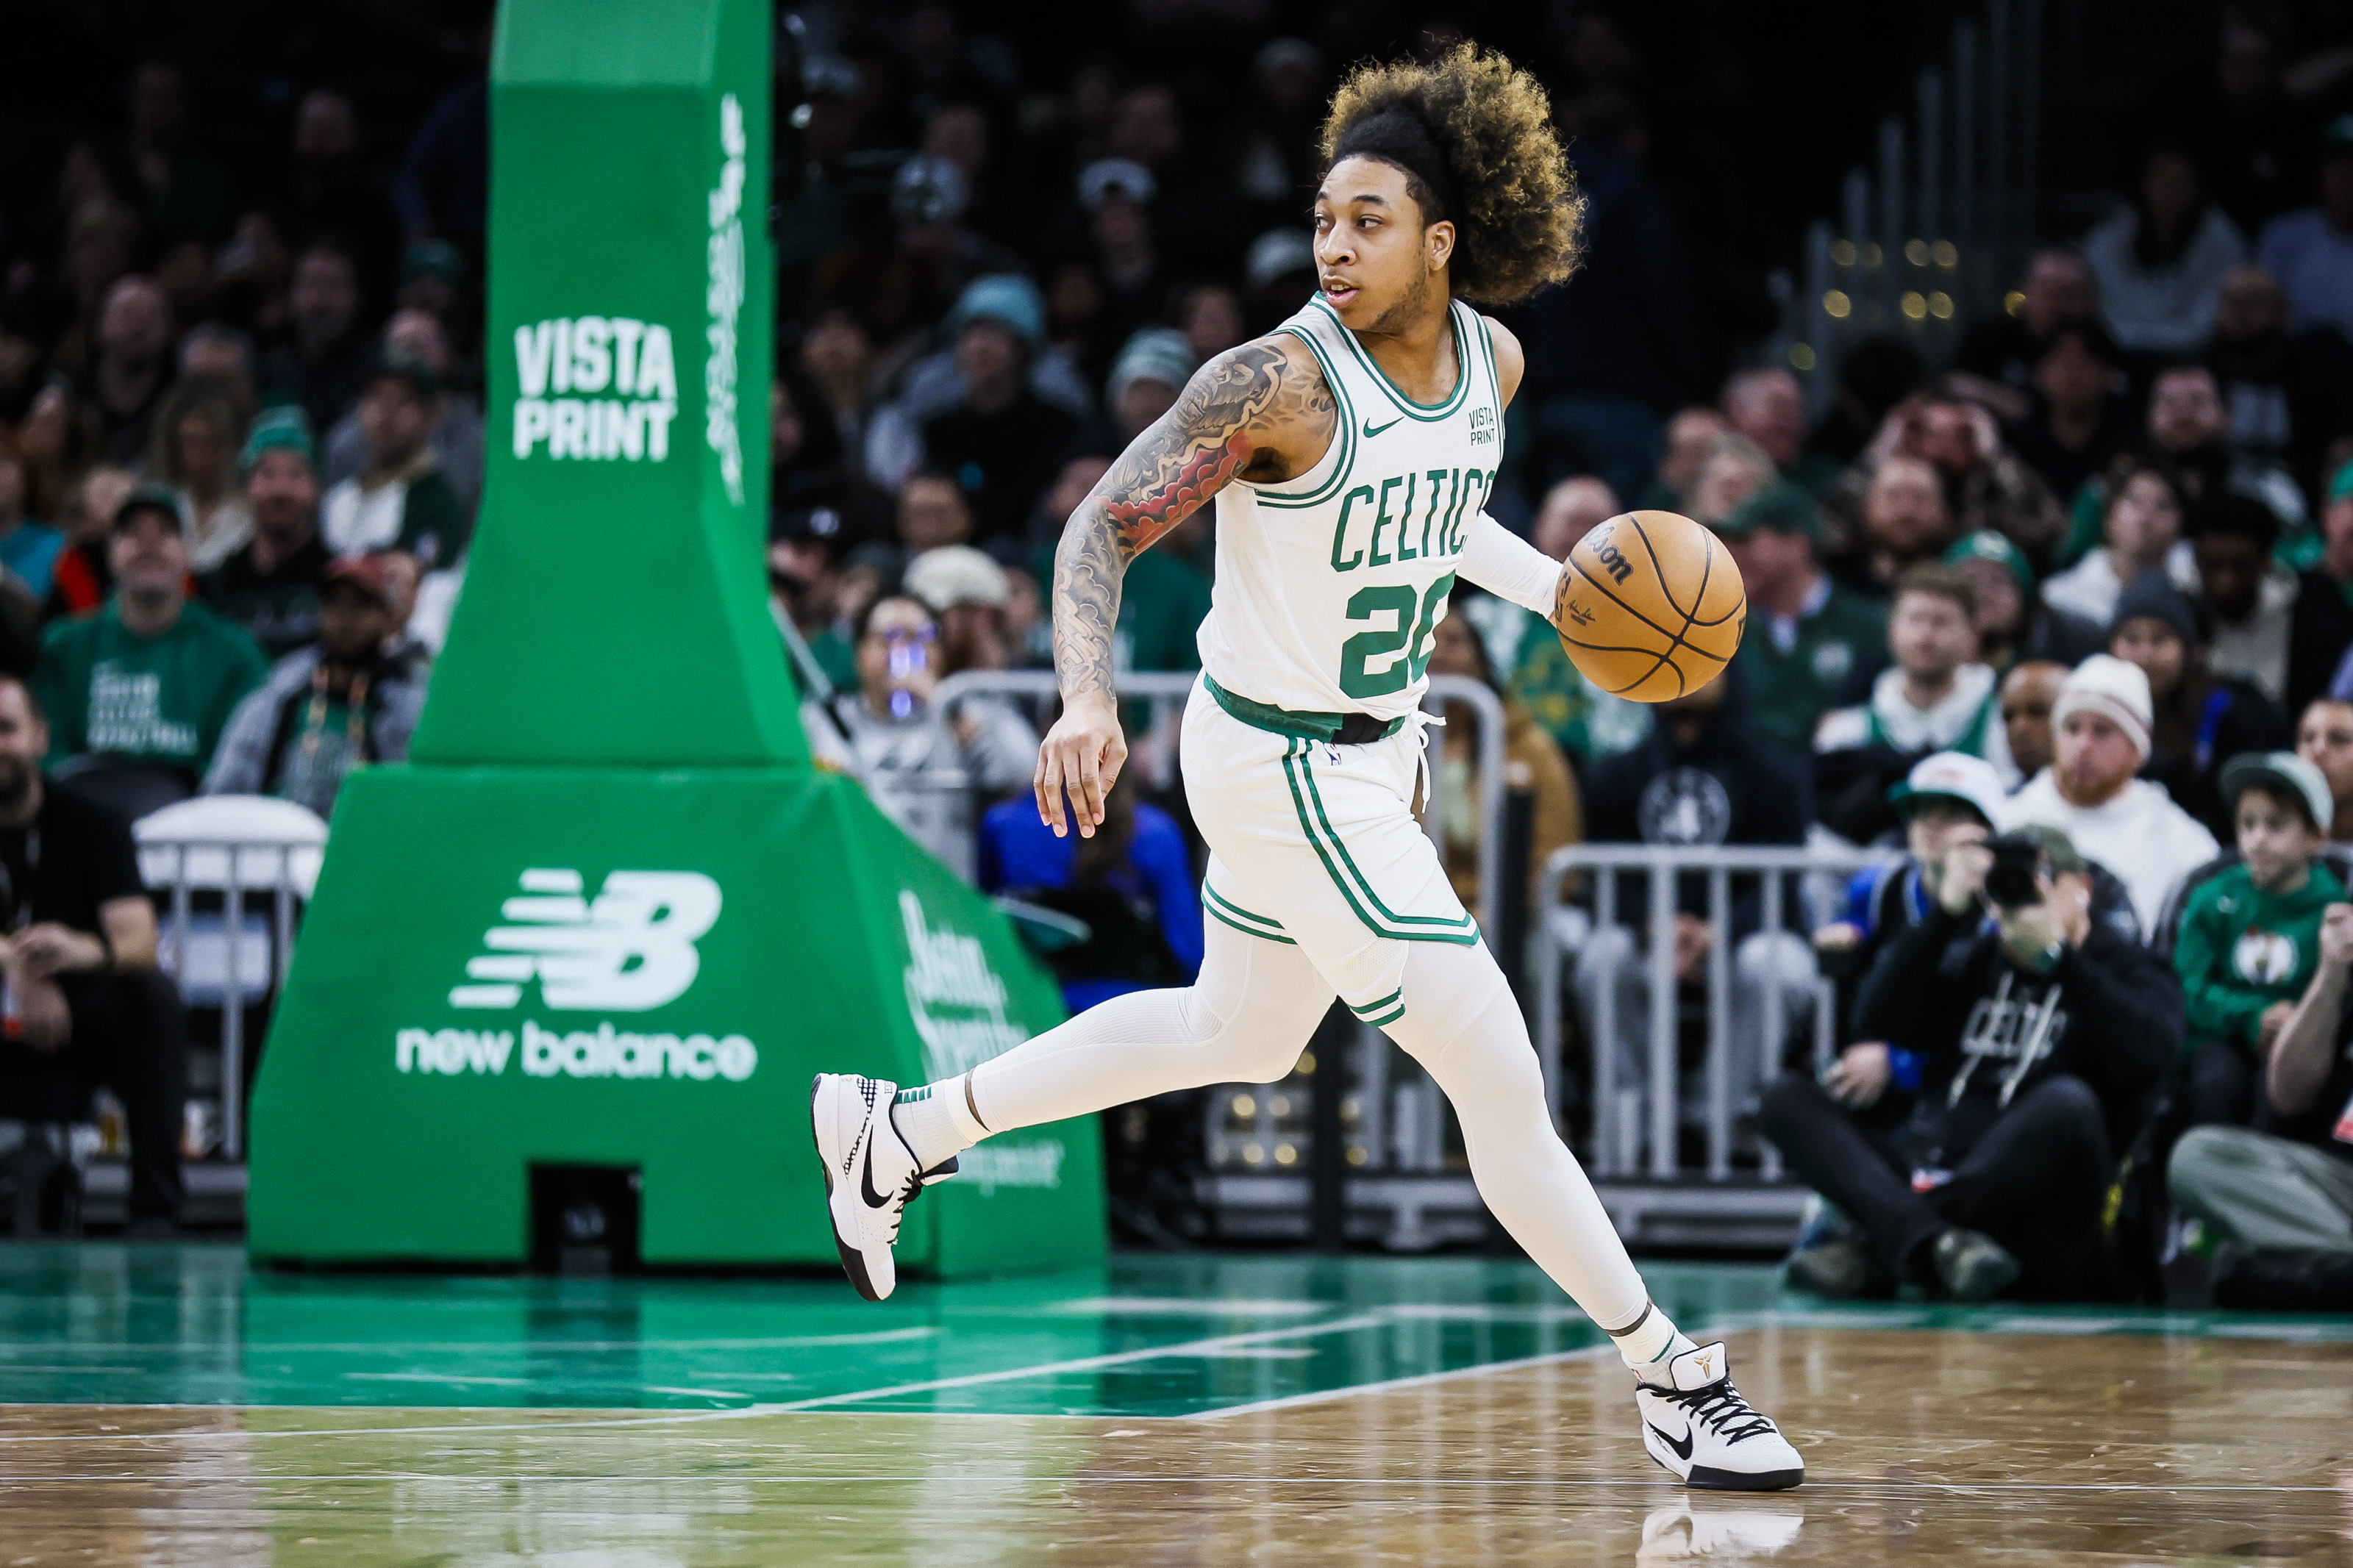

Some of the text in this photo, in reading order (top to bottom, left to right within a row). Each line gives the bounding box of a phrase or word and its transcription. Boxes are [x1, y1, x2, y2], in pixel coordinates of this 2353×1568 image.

[515, 315, 677, 398] VISTA
[513, 398, 678, 462] PRINT
[1468, 407, 1495, 430] VISTA
[1471, 428, 1495, 446] PRINT
[396, 1019, 758, 1082] new balance
